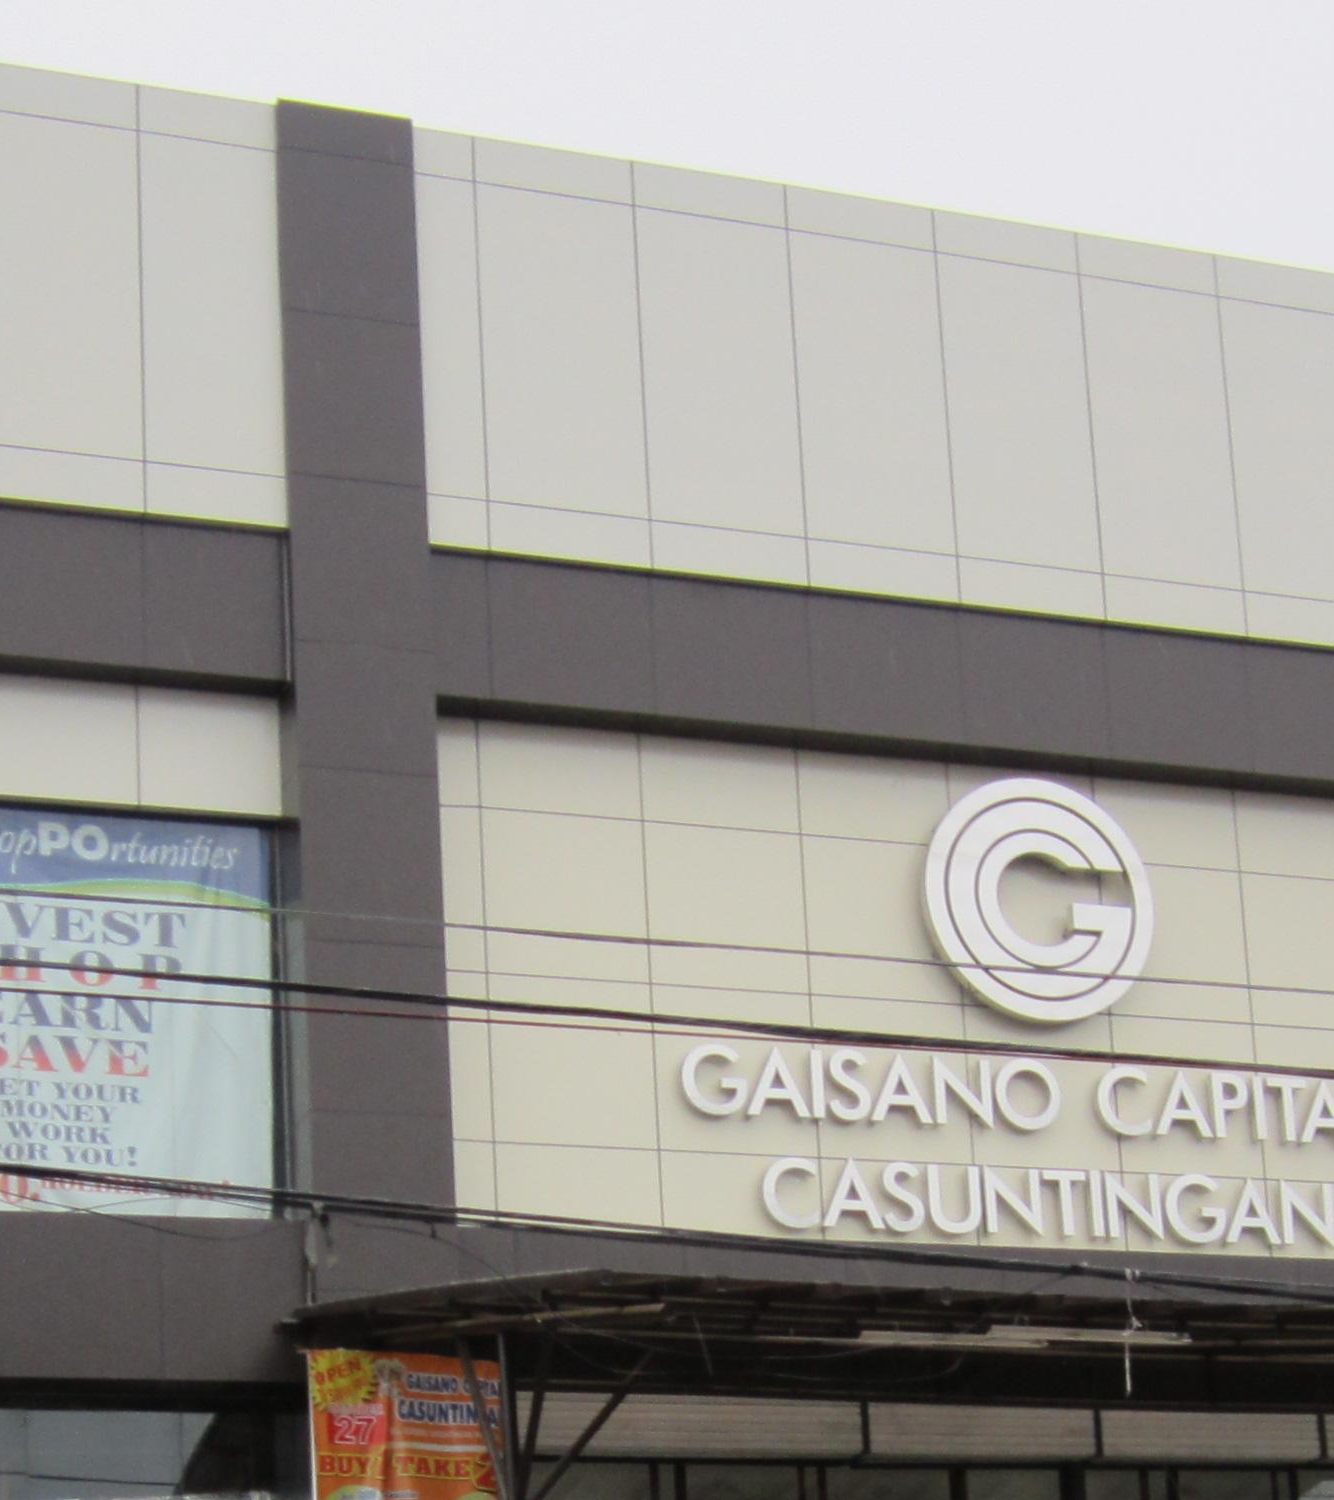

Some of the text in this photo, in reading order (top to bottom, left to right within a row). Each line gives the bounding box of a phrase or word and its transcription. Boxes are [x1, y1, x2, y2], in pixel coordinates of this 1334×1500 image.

[52, 1080, 142, 1105] YOUR
[680, 1043, 1062, 1133] GAISANO
[0, 1099, 116, 1125] MONEY
[4, 1120, 112, 1146] WORK
[62, 1145, 139, 1168] YOU!
[333, 1414, 378, 1446] 27
[319, 1454, 368, 1475] BUY
[395, 1455, 472, 1478] TAKE
